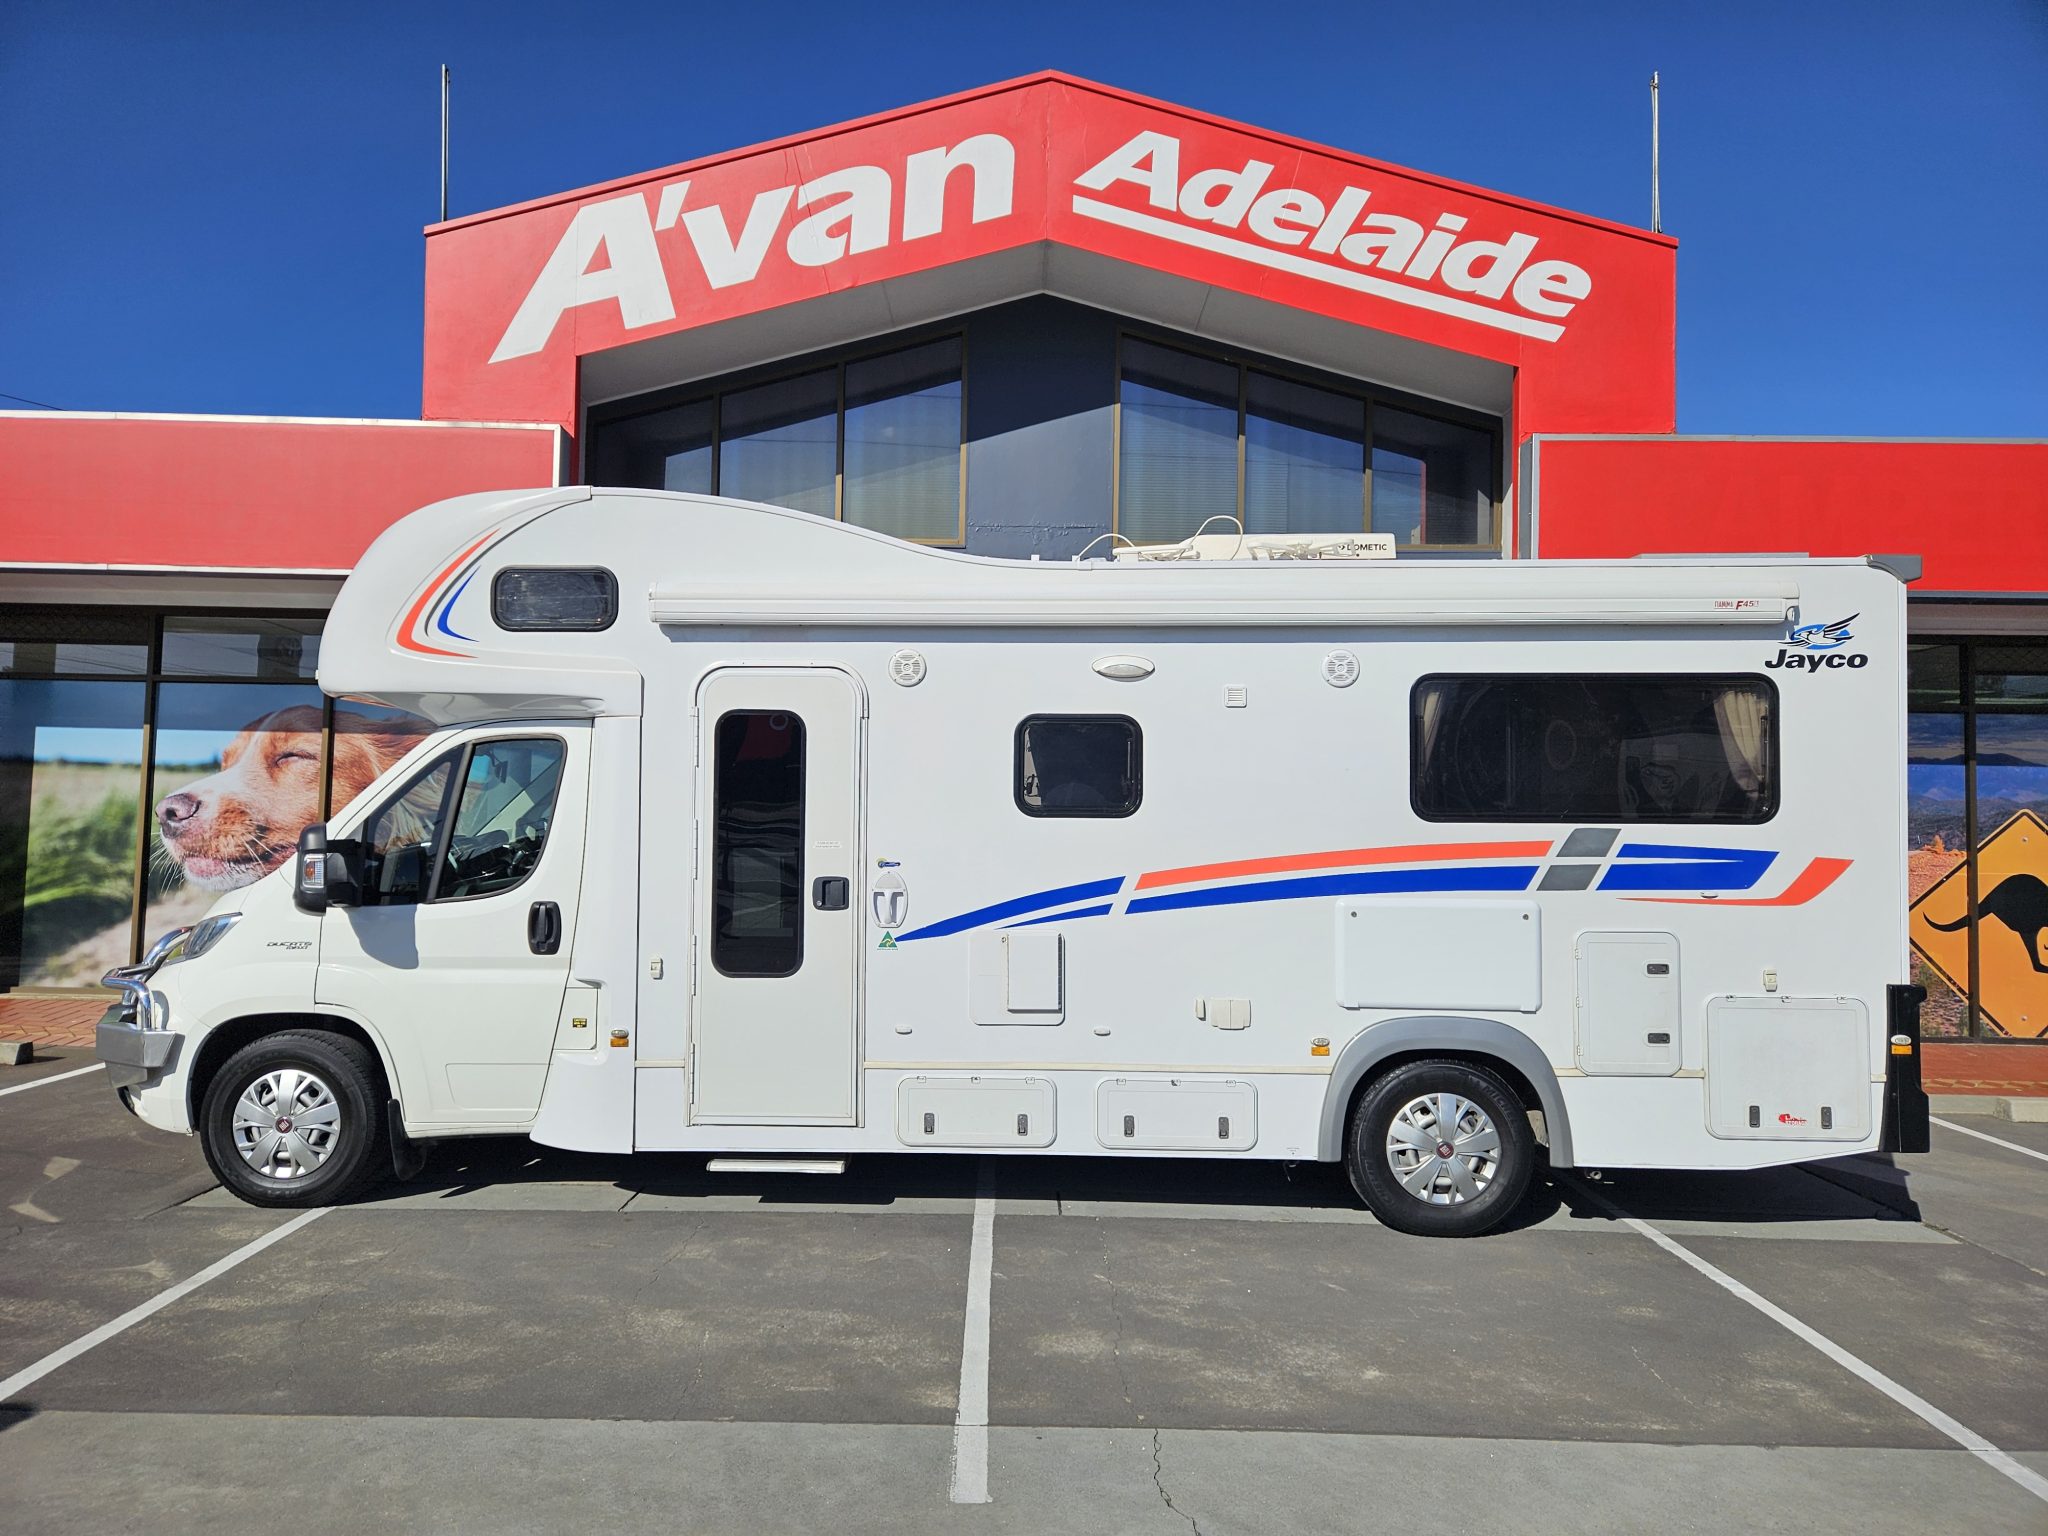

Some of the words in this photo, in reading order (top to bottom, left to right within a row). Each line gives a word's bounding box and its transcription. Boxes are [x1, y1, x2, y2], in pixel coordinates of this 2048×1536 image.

[487, 133, 1016, 364] A'van
[1073, 130, 1592, 317] Adelaide
[1764, 649, 1869, 673] Jayco
